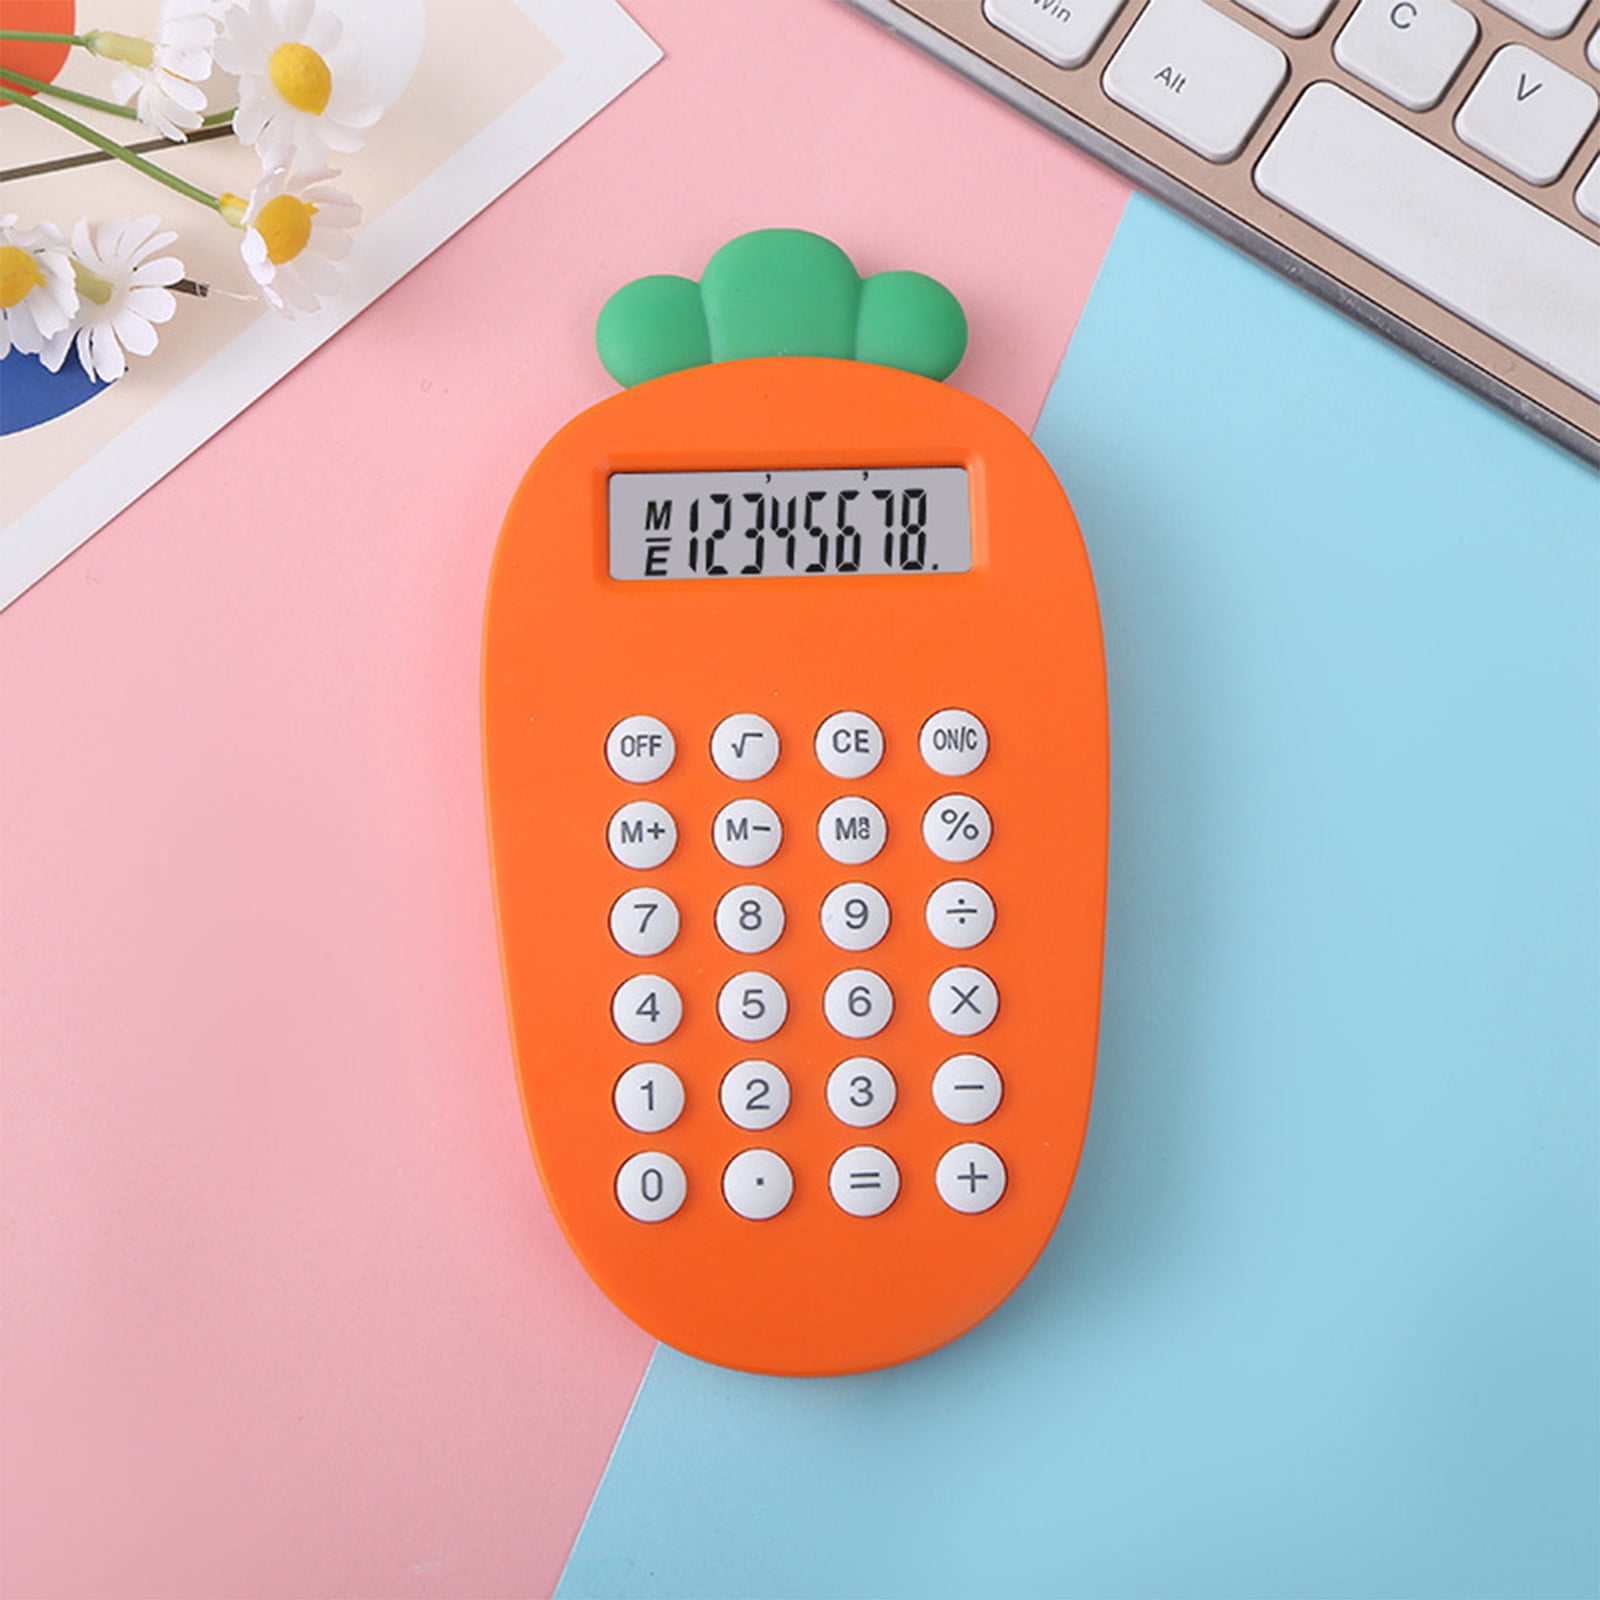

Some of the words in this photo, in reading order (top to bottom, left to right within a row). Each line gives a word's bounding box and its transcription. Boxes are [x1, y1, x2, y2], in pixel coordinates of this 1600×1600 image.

[1390, 2, 1417, 29] C
[1154, 67, 1186, 93] Alt
[1517, 74, 1542, 101] V
[645, 500, 672, 531] M
[644, 545, 670, 576] E
[621, 735, 662, 757] OFF
[832, 729, 870, 754] CE
[933, 727, 978, 753] ON/C
[621, 820, 666, 844] M+
[634, 904, 658, 933] 7
[739, 900, 762, 931] 8
[845, 899, 869, 930] 9
[636, 992, 660, 1023] 4
[742, 989, 766, 1020] 5
[848, 986, 872, 1017] 6
[640, 1080, 654, 1111] 1
[746, 1079, 770, 1111] 2
[850, 1076, 874, 1107] 3
[641, 1169, 663, 1202] 0
